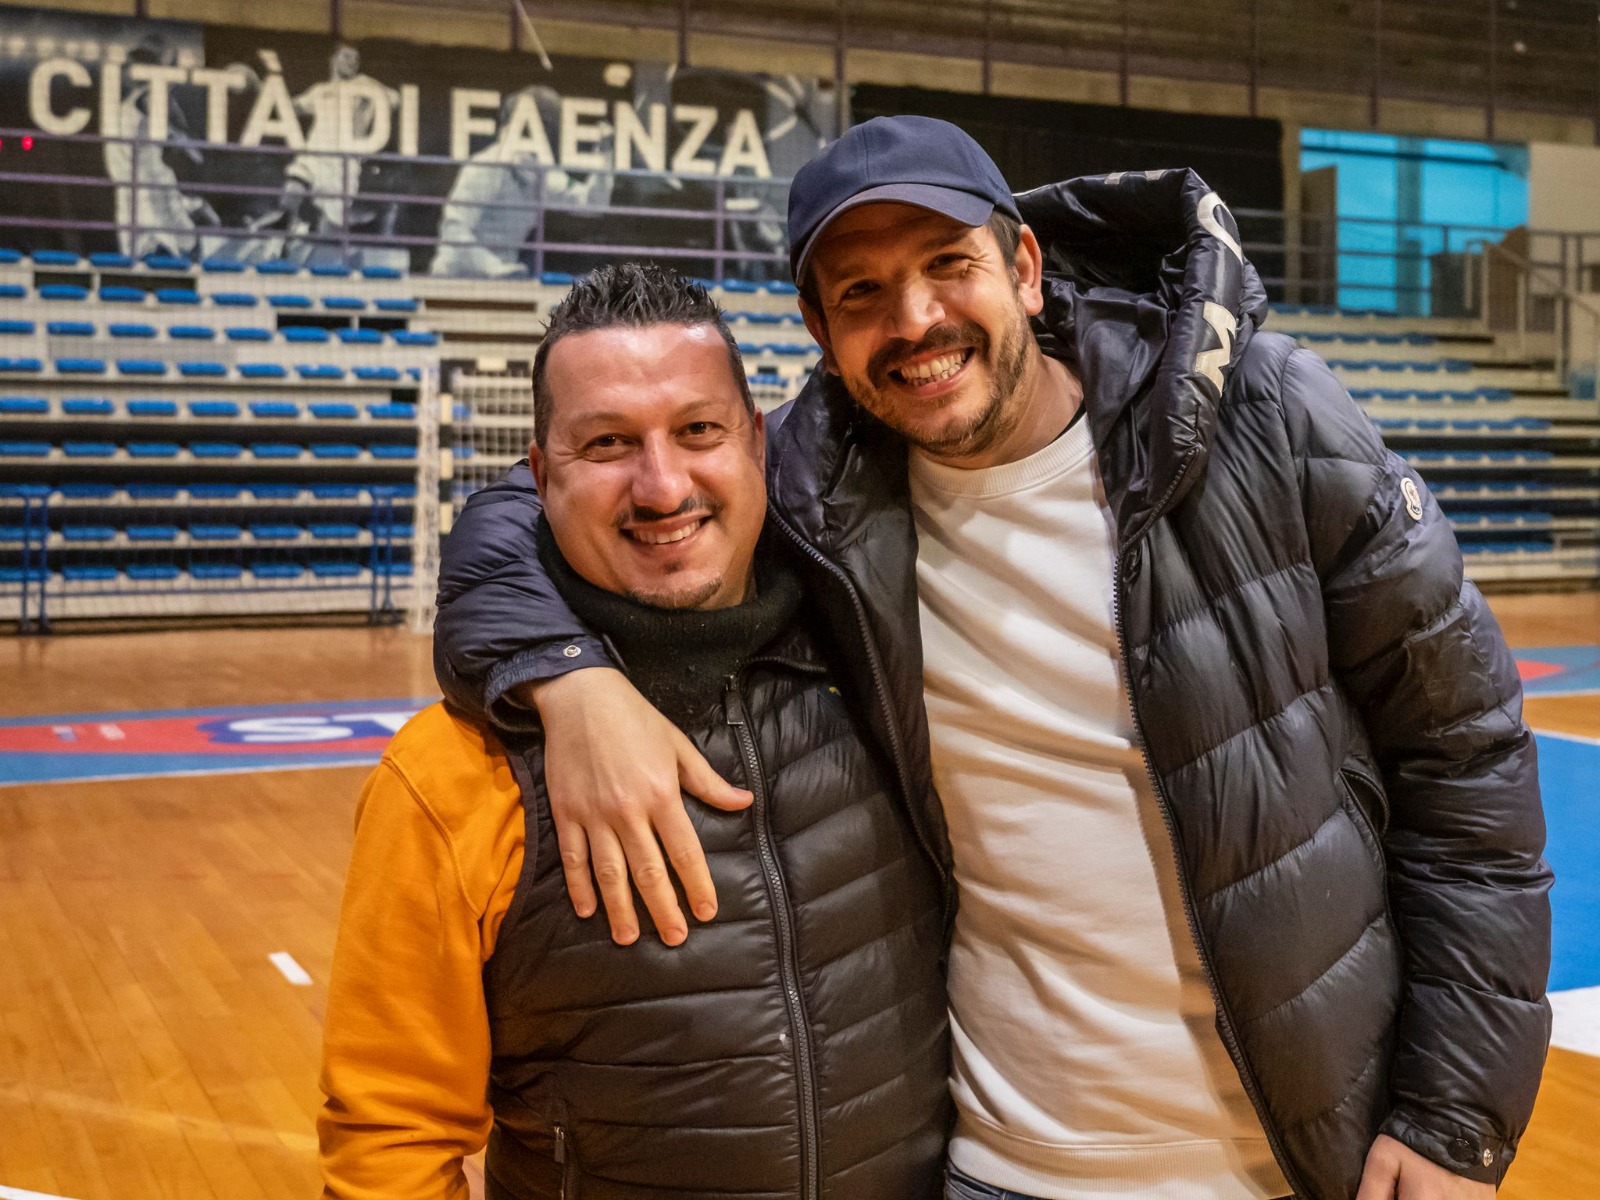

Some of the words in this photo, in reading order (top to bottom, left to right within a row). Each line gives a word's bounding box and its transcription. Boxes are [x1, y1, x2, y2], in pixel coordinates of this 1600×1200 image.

[28, 50, 304, 149] CITTÀ
[340, 82, 419, 156] DI
[451, 87, 772, 178] FAENZA
